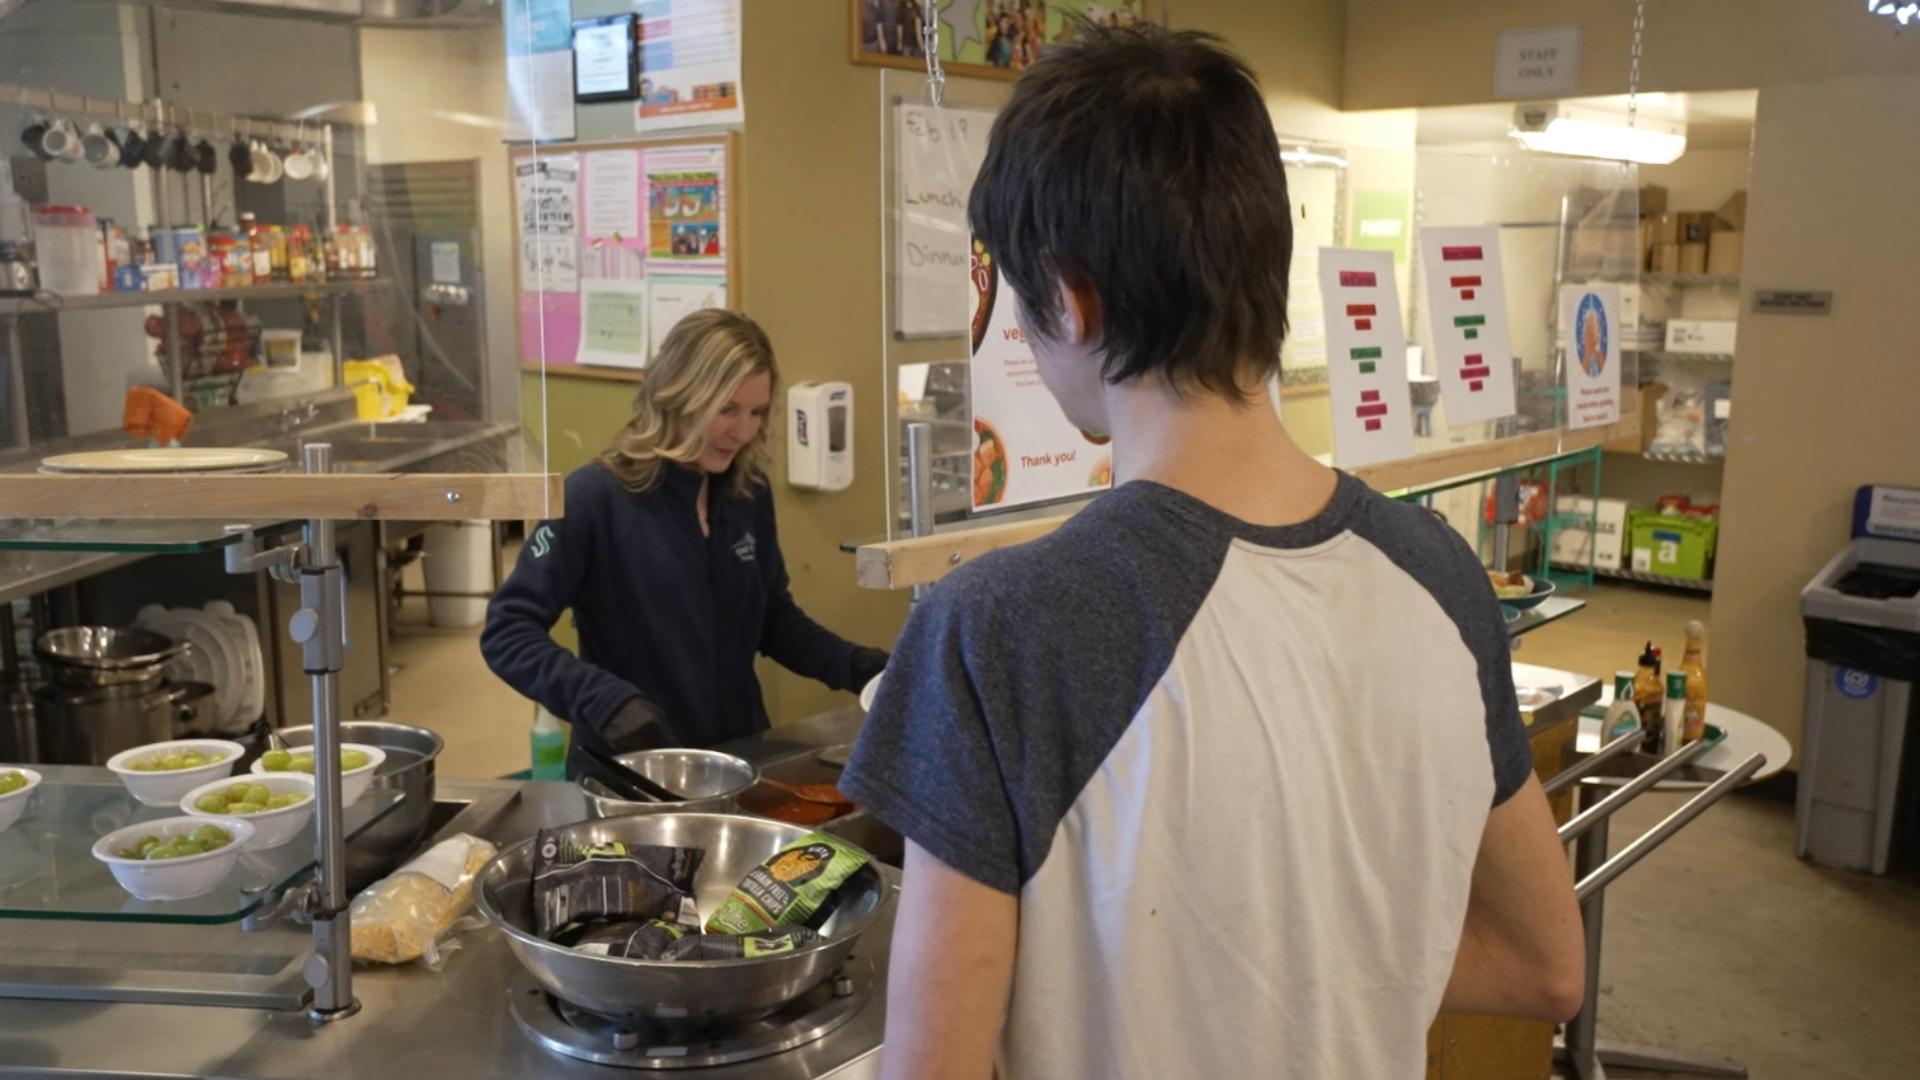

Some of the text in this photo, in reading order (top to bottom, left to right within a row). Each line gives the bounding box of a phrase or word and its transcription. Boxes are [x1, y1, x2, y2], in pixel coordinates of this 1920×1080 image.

[904, 185, 966, 208] Lunch
[1020, 449, 1077, 469] Thank you!
